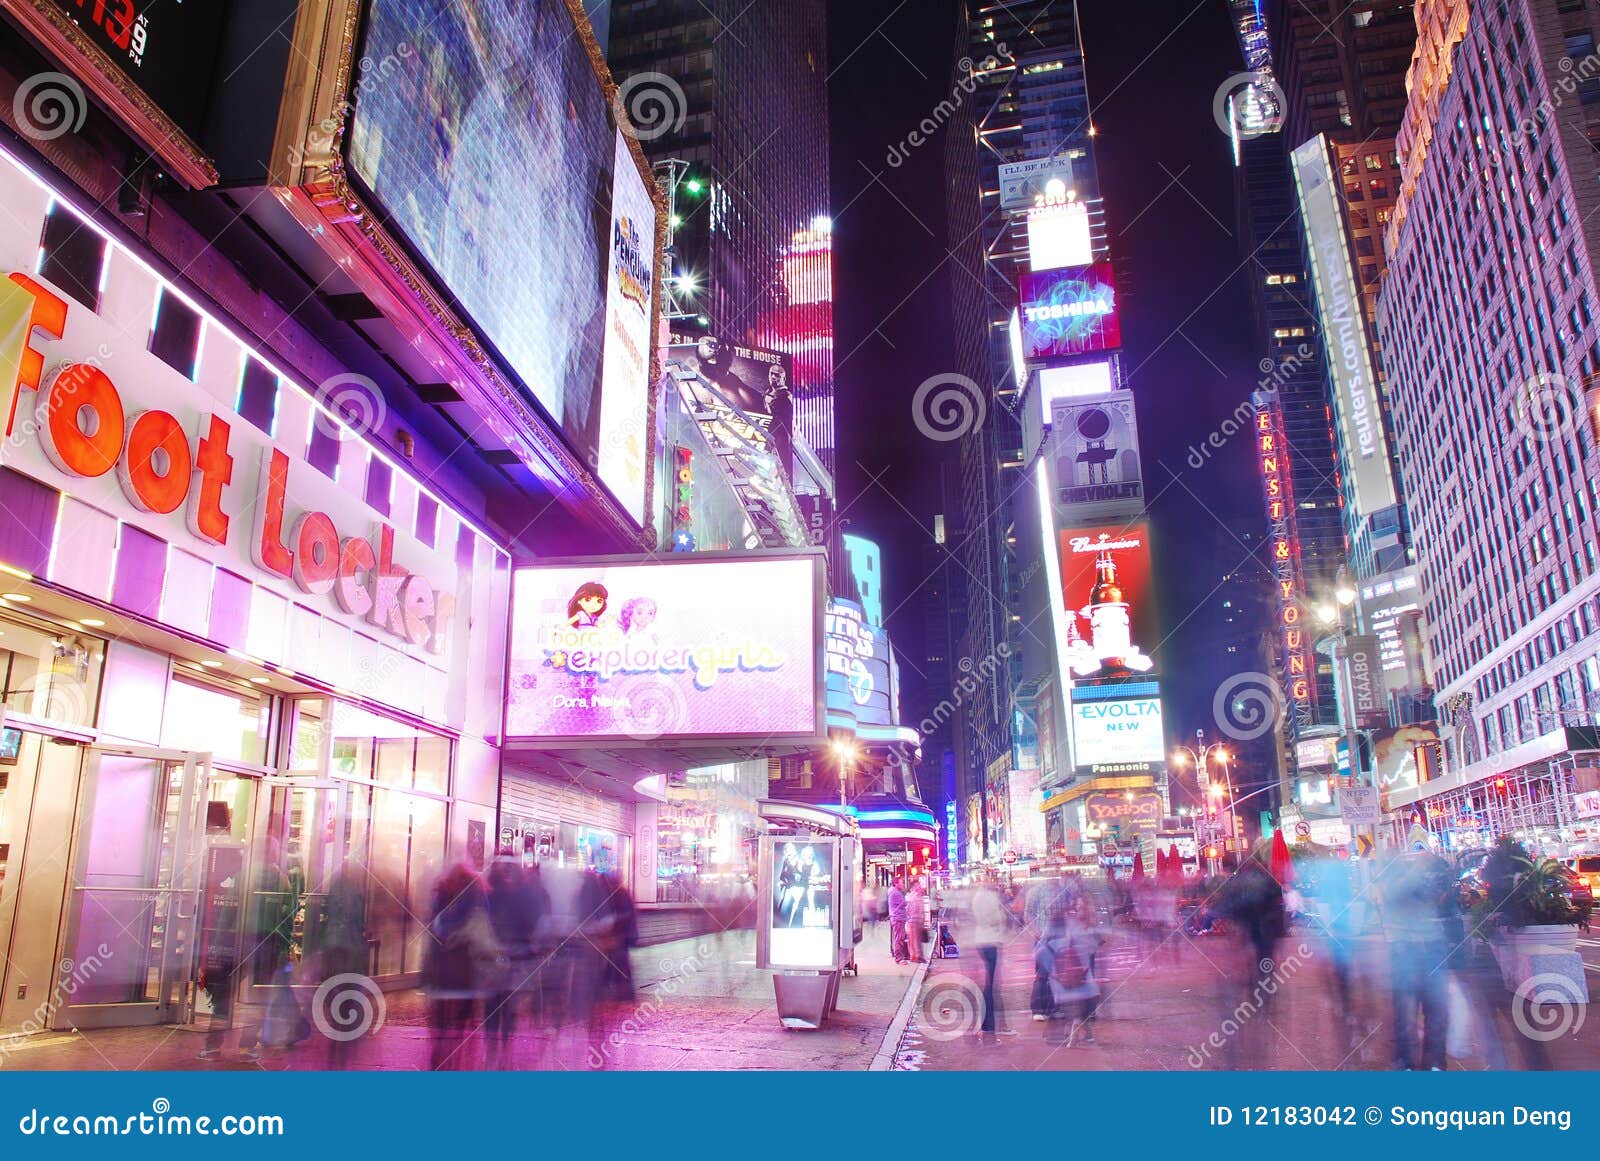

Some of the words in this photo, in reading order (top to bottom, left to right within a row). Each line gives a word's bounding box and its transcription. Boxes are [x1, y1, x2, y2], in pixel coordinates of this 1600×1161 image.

[137, 13, 150, 28] AT
[128, 49, 142, 67] PM
[1025, 300, 1109, 321] TOSHIBA
[734, 346, 751, 359] THE
[753, 350, 782, 365] HOUSE
[1257, 412, 1281, 518] ERNST
[679, 446, 693, 521] TOYS
[1069, 536, 1141, 552] Budweiser
[1276, 541, 1290, 559] &
[1279, 581, 1308, 699] YOUNG
[1077, 702, 1160, 718] EVOLTA
[1107, 722, 1139, 731] NEW
[1092, 762, 1149, 773] Panasonic
